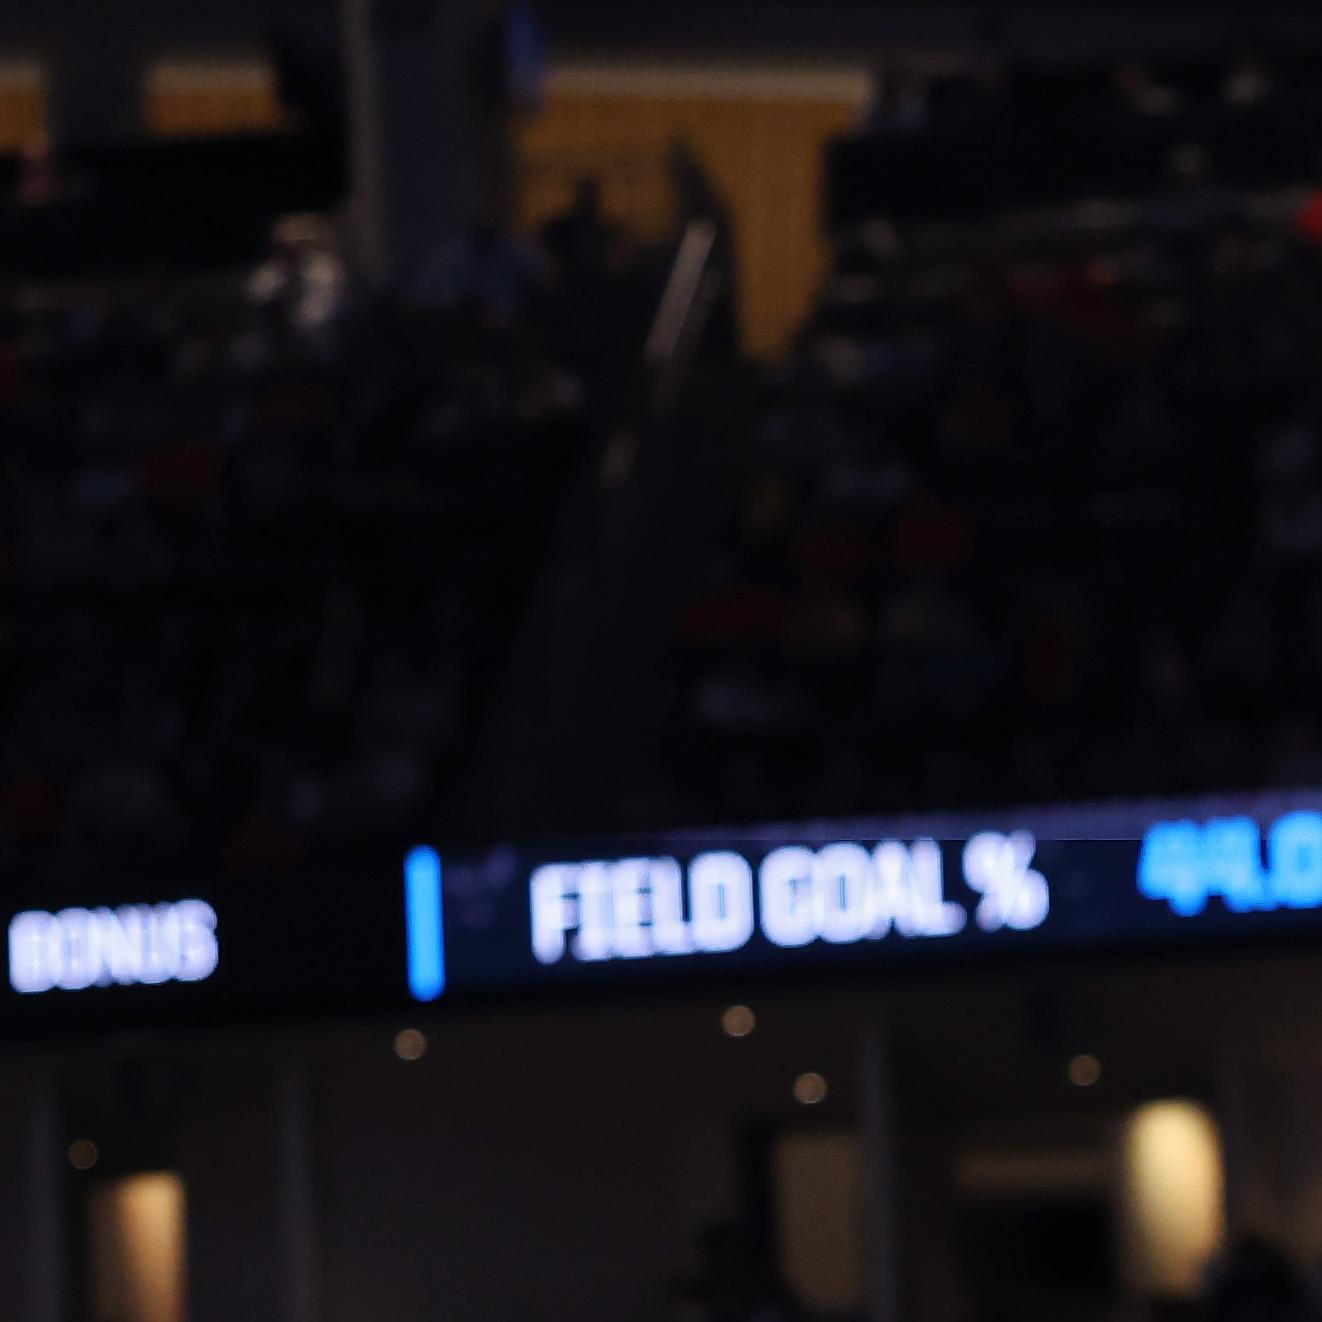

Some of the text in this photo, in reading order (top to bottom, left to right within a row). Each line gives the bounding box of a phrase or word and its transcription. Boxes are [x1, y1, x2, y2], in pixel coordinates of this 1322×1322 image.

[8, 898, 219, 993] BONUS
[529, 851, 754, 965] FIELD
[759, 838, 968, 948] GOAL
[962, 830, 1050, 932] %
